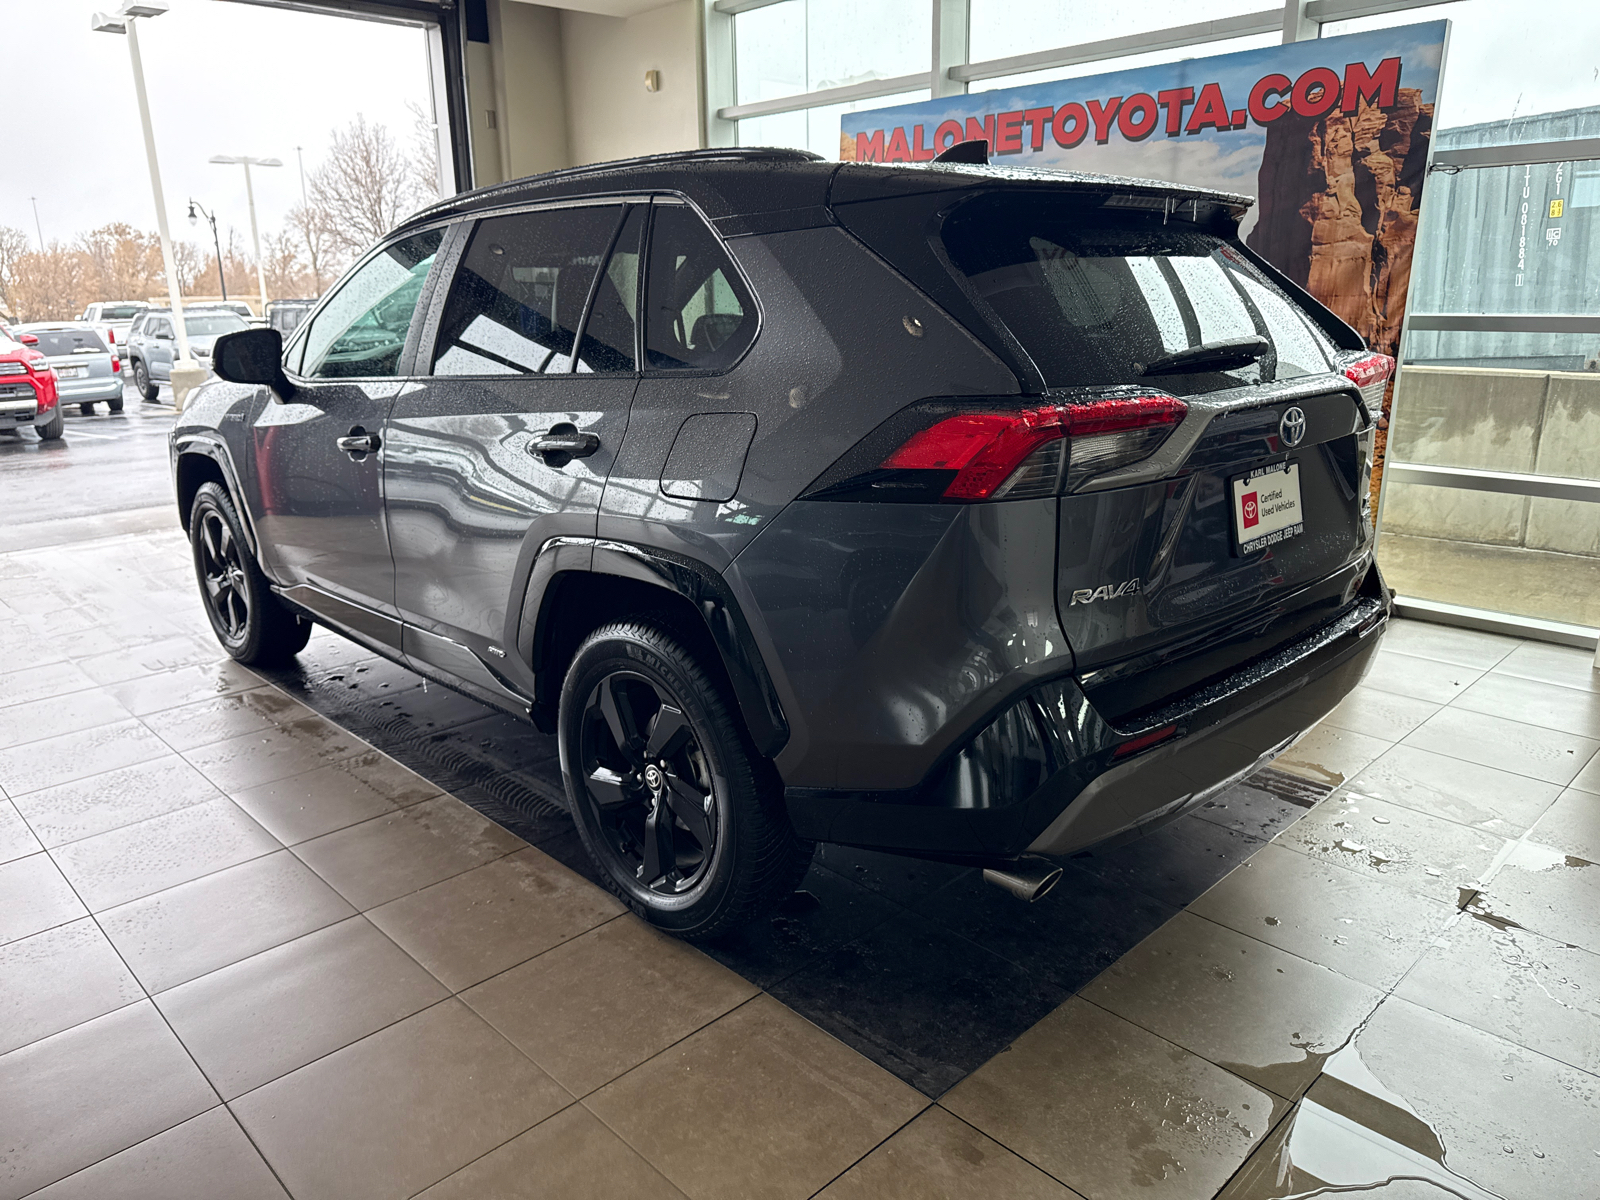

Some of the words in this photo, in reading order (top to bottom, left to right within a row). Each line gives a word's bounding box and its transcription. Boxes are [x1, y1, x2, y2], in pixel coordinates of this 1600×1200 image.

[856, 56, 1402, 162] MALONETOYOTA.COM
[1518, 202, 1528, 270] 081884
[1250, 468, 1265, 479] KARL
[1265, 462, 1286, 474] MALONE
[1260, 488, 1283, 503] Certified
[1261, 506, 1274, 517] Used
[1274, 500, 1295, 512] Vehicles
[1243, 538, 1267, 554] CHRYSLER
[1267, 531, 1282, 545] DODGE
[1283, 527, 1293, 540] JEEP
[1293, 523, 1303, 535] RAM
[1069, 577, 1140, 607] RAV4
